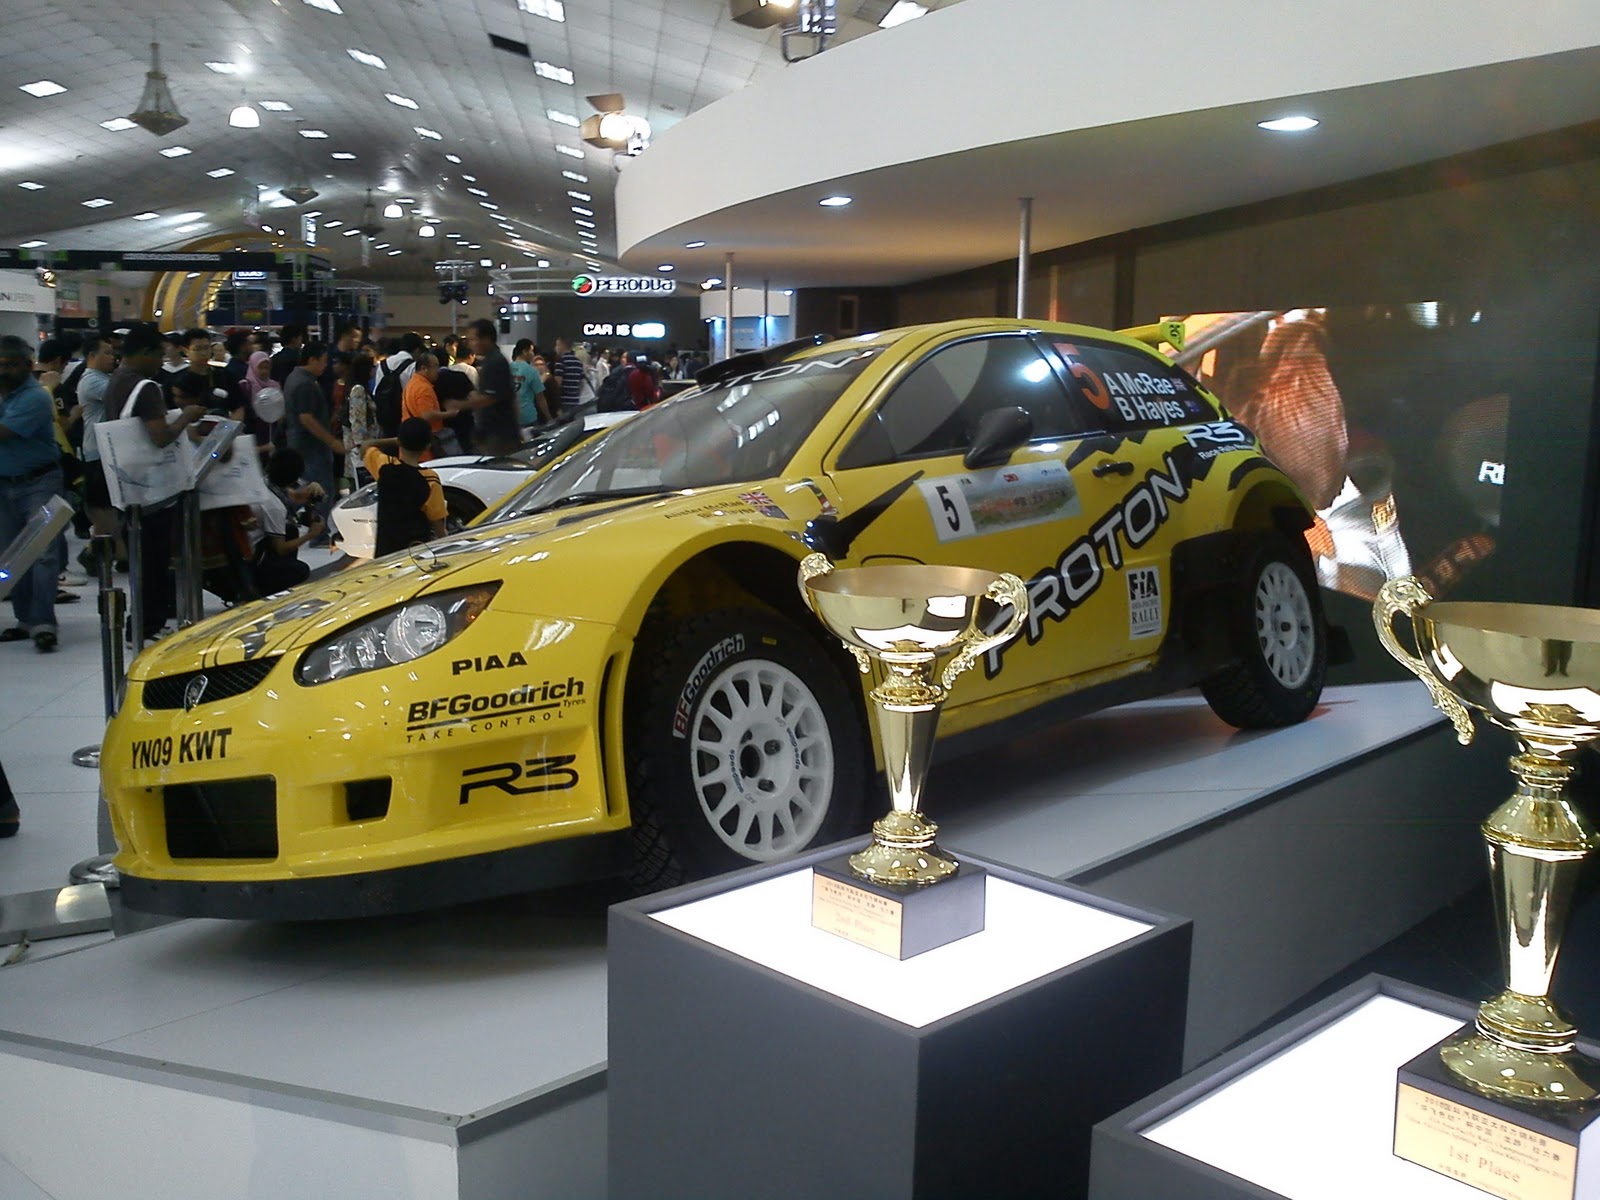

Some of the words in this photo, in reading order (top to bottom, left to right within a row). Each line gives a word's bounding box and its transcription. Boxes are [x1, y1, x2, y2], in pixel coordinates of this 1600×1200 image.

[583, 323, 613, 336] CAR
[616, 324, 630, 336] IS
[1052, 342, 1111, 410] 5
[1102, 372, 1122, 396] A
[1115, 372, 1176, 396] McRae
[1113, 396, 1137, 422] B
[1130, 396, 1186, 426] Hayes
[1177, 421, 1246, 448] R3
[935, 485, 961, 532] 5
[1131, 607, 1159, 625] RALLY
[451, 651, 528, 676] PIAA
[406, 676, 585, 723] BFGoodrich
[675, 635, 744, 734] BFGoodrich
[562, 697, 587, 708] Tyres
[406, 728, 454, 744] TAKE
[470, 710, 564, 733] CONTROL
[131, 735, 173, 770] YN09
[178, 726, 233, 764] KWT
[458, 753, 580, 806] R3
[1449, 1145, 1469, 1164] 1st
[1479, 1156, 1521, 1184] Place
